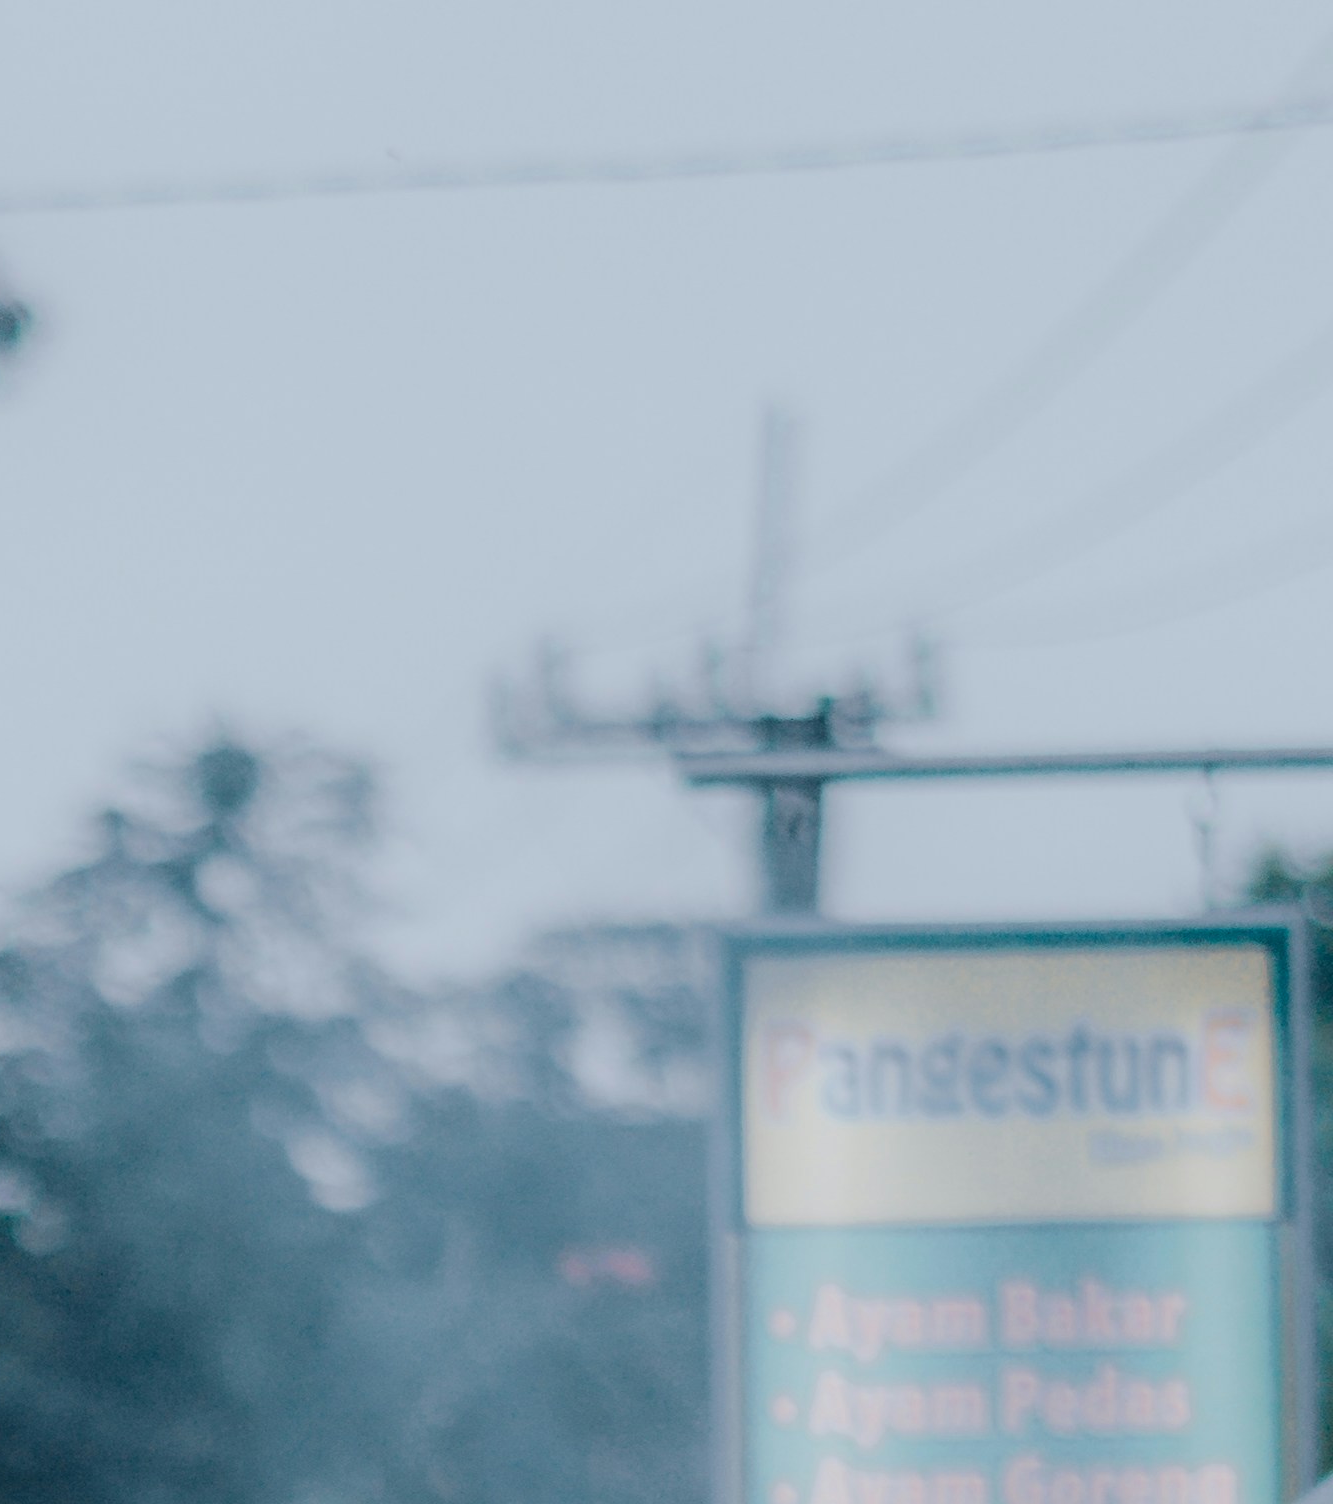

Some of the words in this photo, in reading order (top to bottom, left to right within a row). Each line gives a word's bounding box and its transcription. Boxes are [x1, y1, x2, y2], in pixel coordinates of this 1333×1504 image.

[810, 1282, 986, 1362] Ayam
[1000, 1278, 1185, 1344] Bakar
[810, 1368, 988, 1448] Ayam
[1001, 1366, 1192, 1434] Pedas
